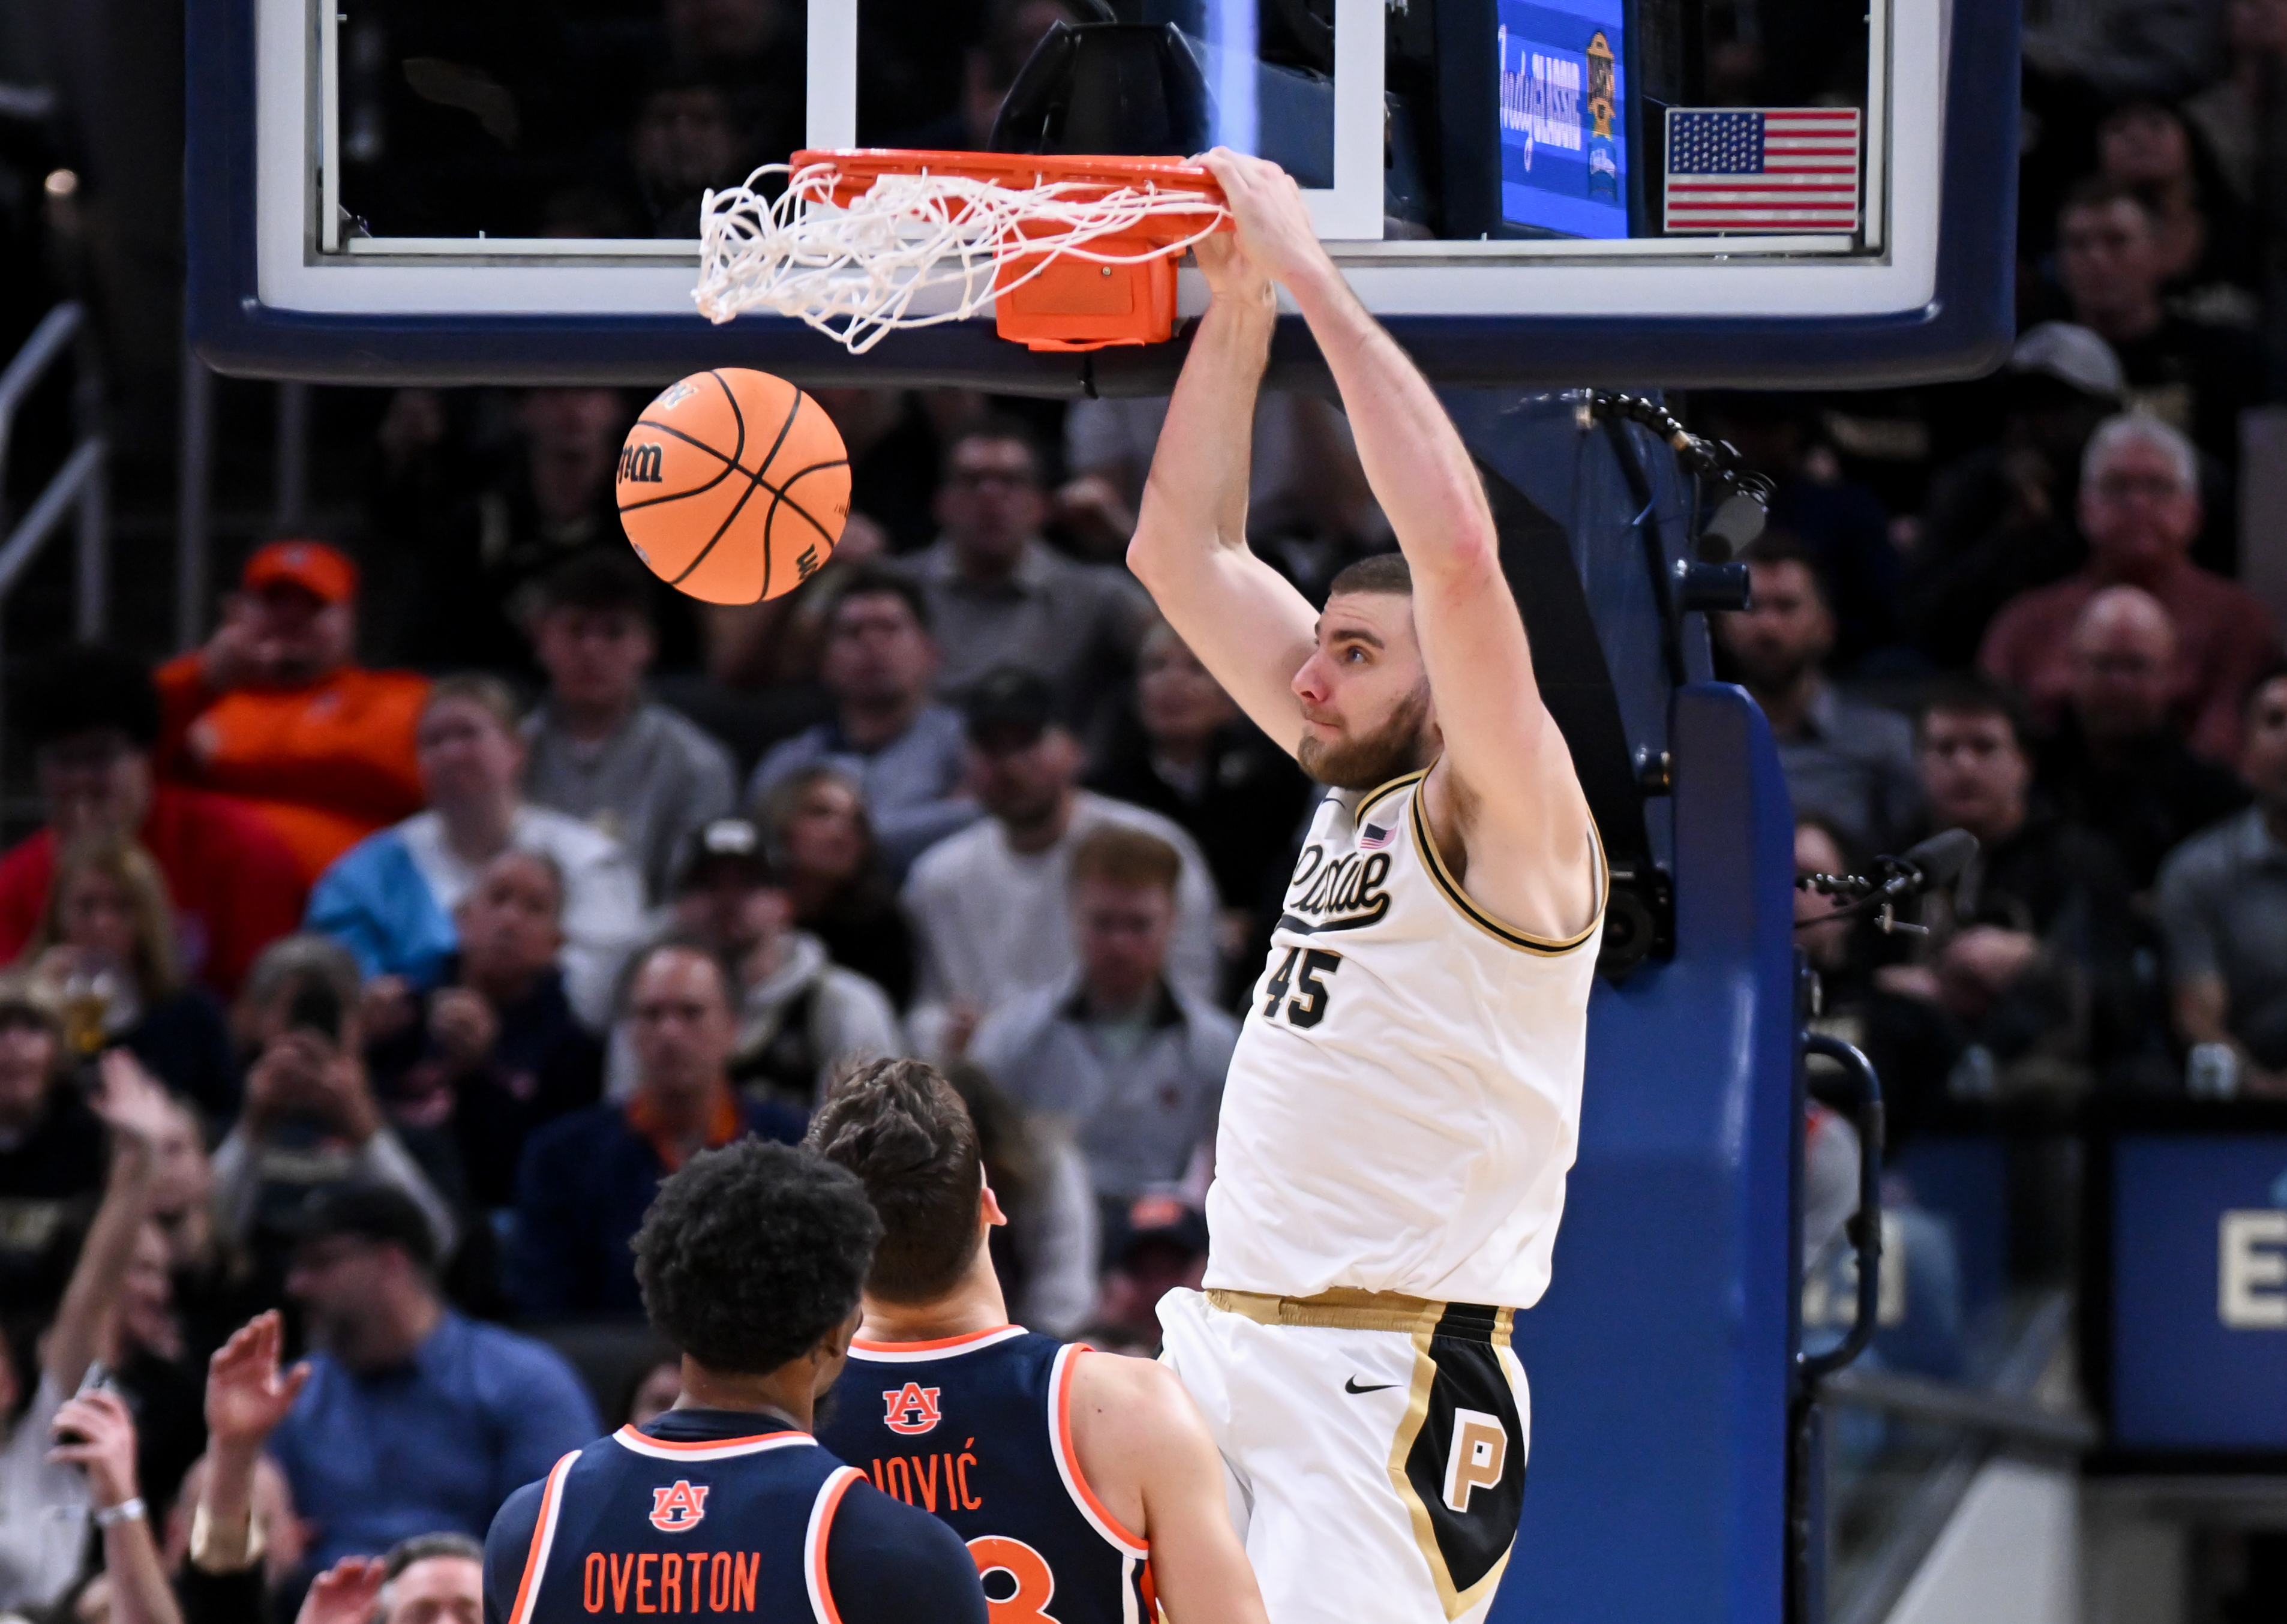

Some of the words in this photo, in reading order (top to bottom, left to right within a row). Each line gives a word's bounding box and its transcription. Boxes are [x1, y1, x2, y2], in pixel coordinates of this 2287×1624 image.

[1263, 947, 1343, 1030] 45
[1442, 1407, 1508, 1513] P
[583, 1551, 760, 1614] OVERTON
